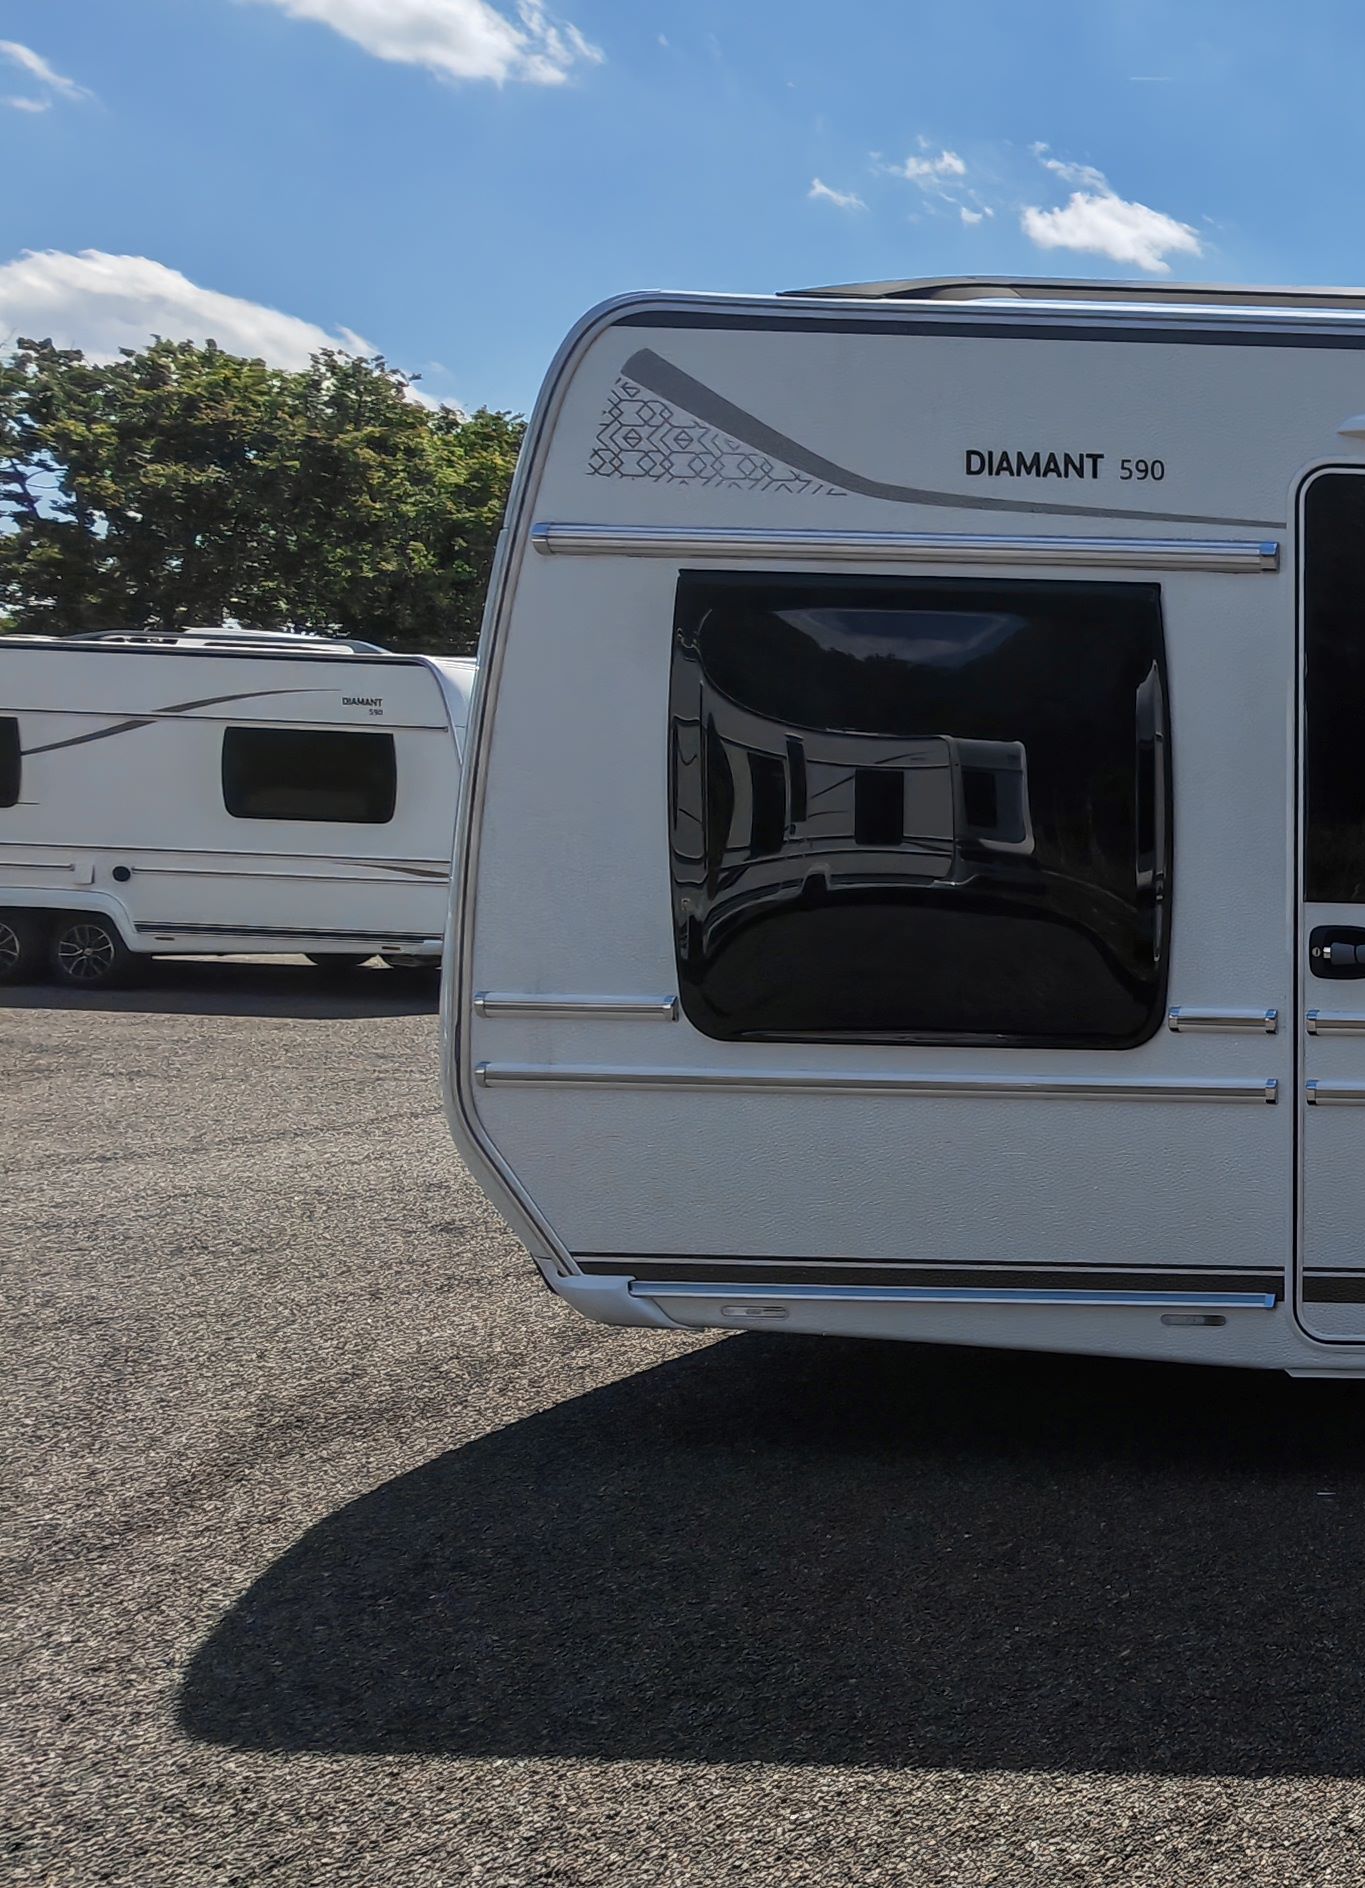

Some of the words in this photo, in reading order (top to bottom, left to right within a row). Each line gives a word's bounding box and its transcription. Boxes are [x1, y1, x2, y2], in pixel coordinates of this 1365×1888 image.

[965, 450, 1104, 479] DIAMANT
[1119, 459, 1165, 481] 590
[342, 697, 383, 707] DIAMANT
